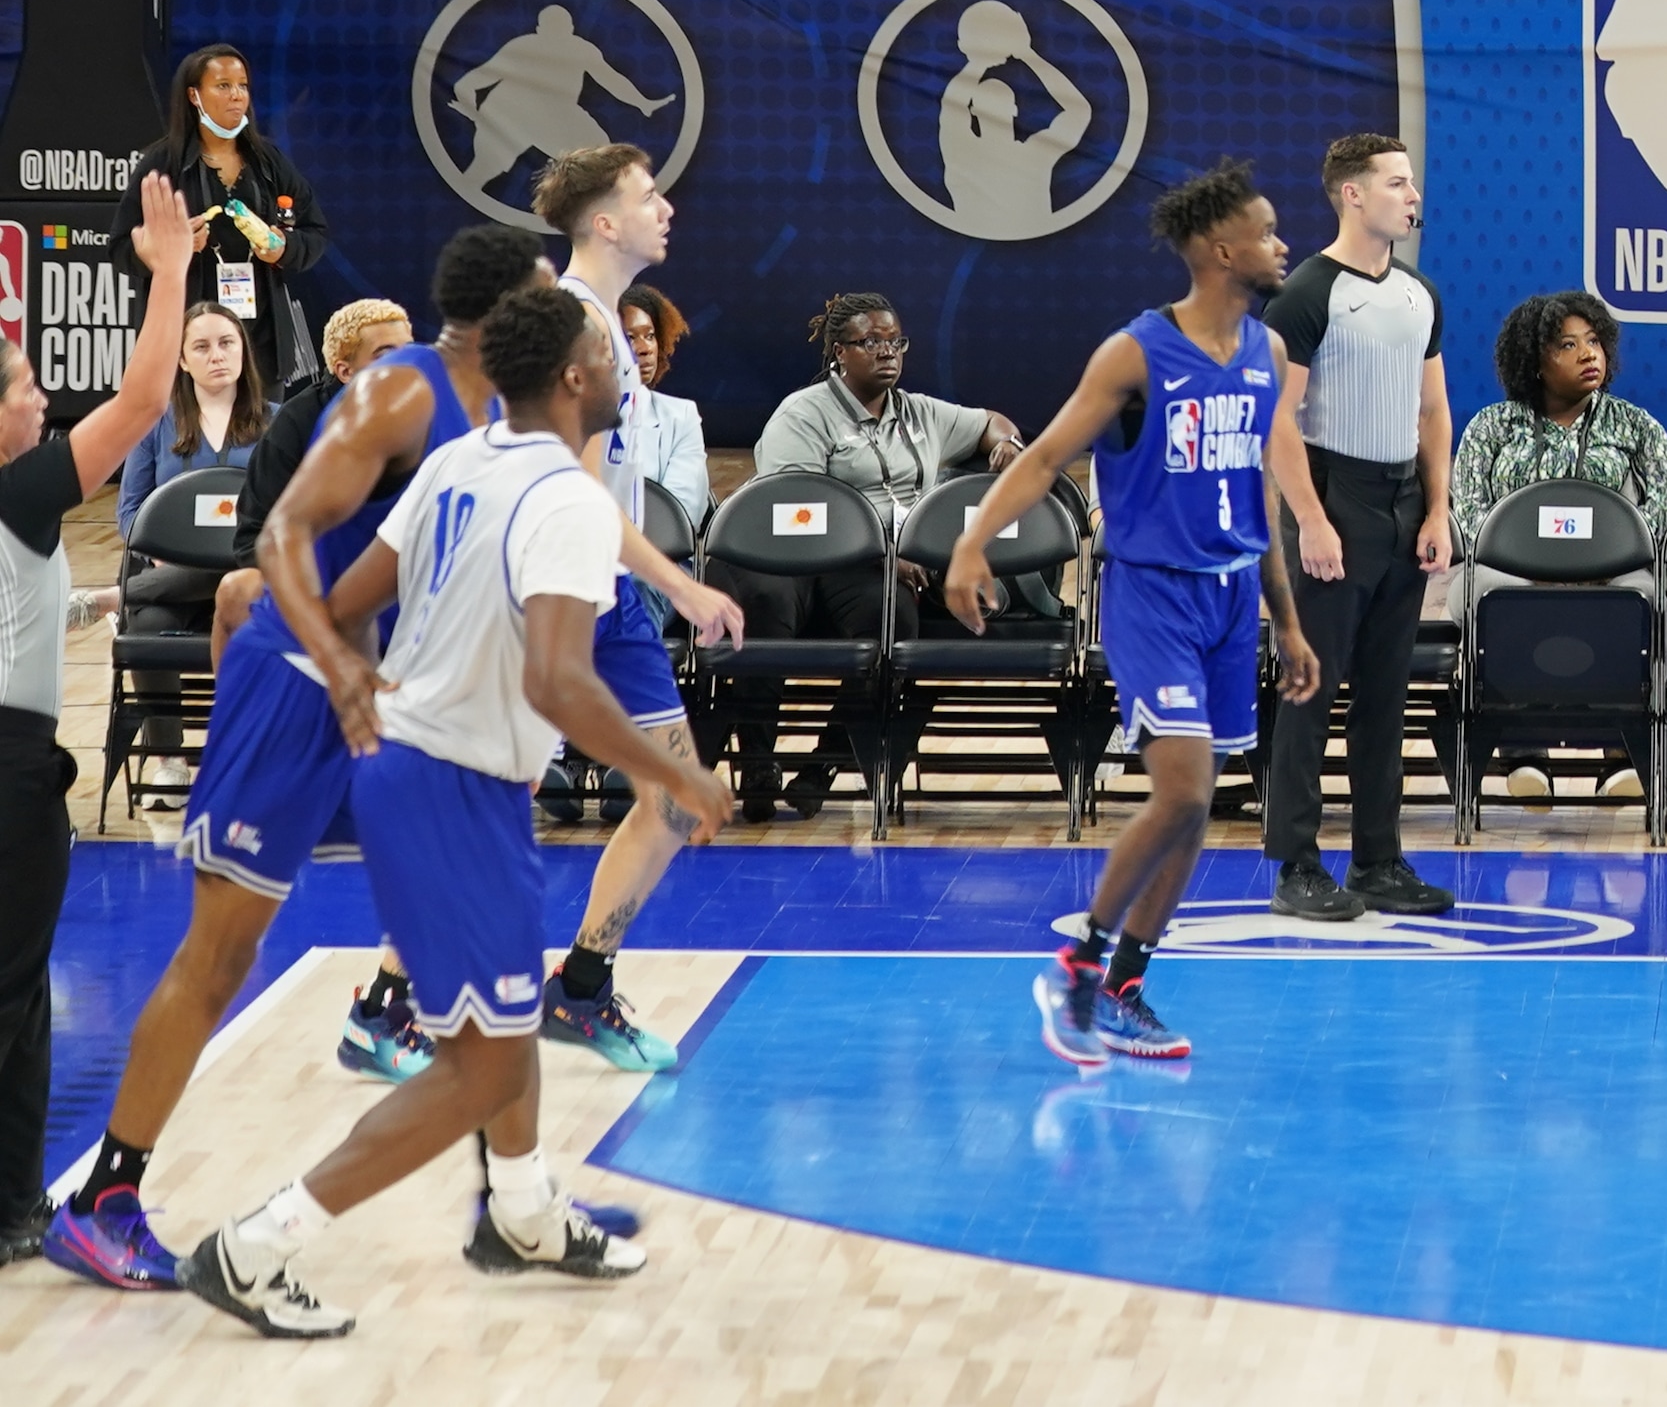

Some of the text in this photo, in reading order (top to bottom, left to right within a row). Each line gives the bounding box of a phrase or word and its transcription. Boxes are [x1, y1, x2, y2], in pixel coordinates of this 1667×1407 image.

[20, 149, 144, 192] @NBADraf
[1203, 394, 1256, 434] DRAFT
[1218, 478, 1232, 532] 3
[1554, 518, 1576, 535] 76
